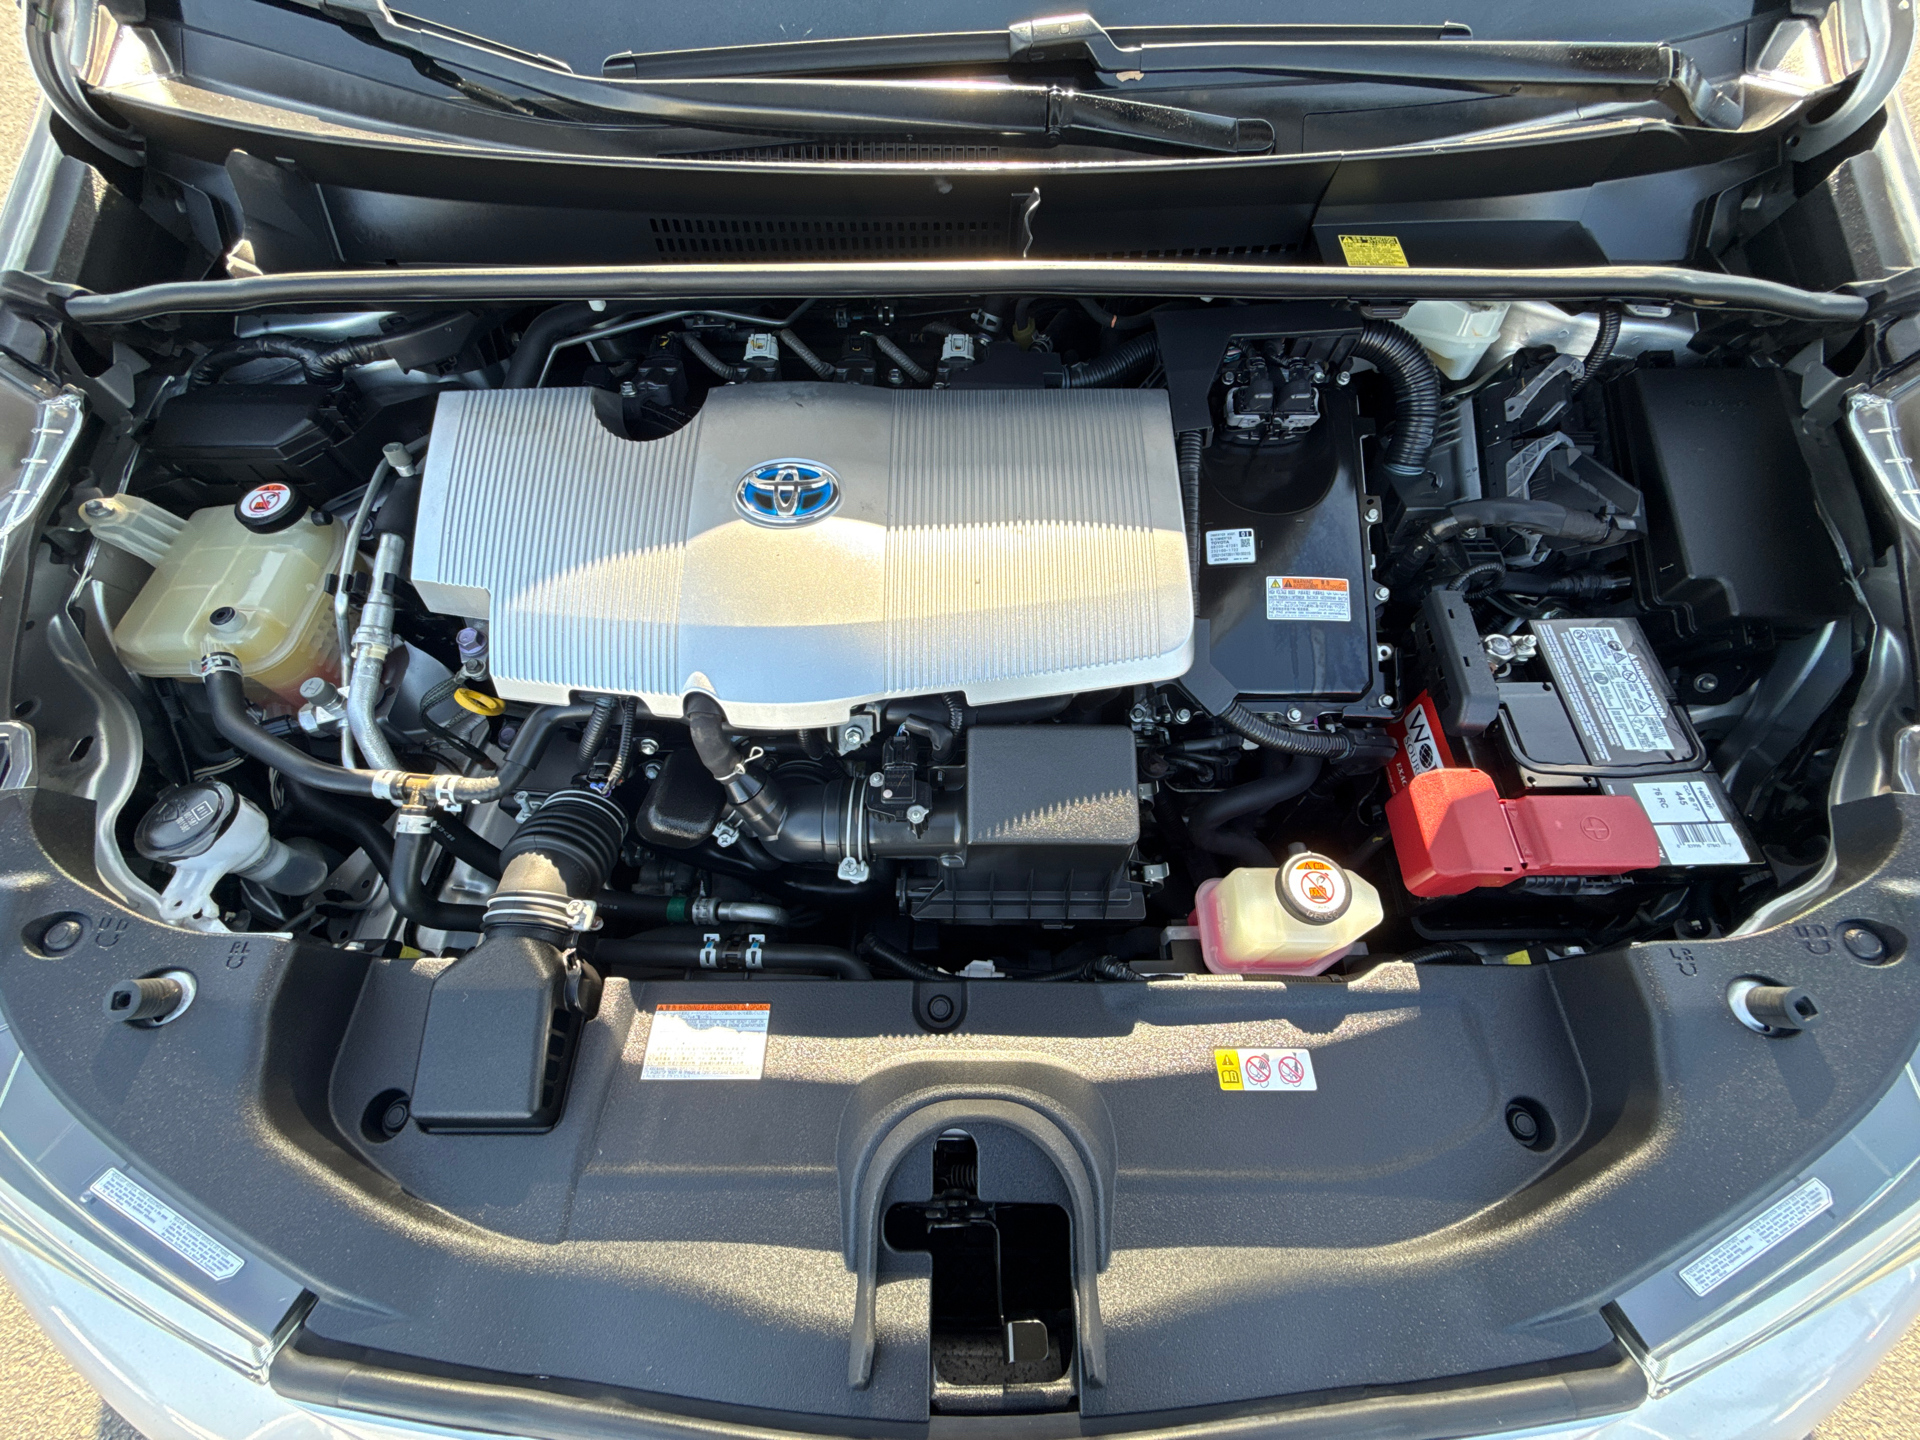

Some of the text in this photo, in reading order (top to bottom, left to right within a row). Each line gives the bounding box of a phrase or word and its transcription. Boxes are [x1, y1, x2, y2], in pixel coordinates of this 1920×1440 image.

[1404, 736, 1420, 775] SOUR
[1652, 787, 1668, 808] 76 RC
[1674, 790, 1689, 806] 445
